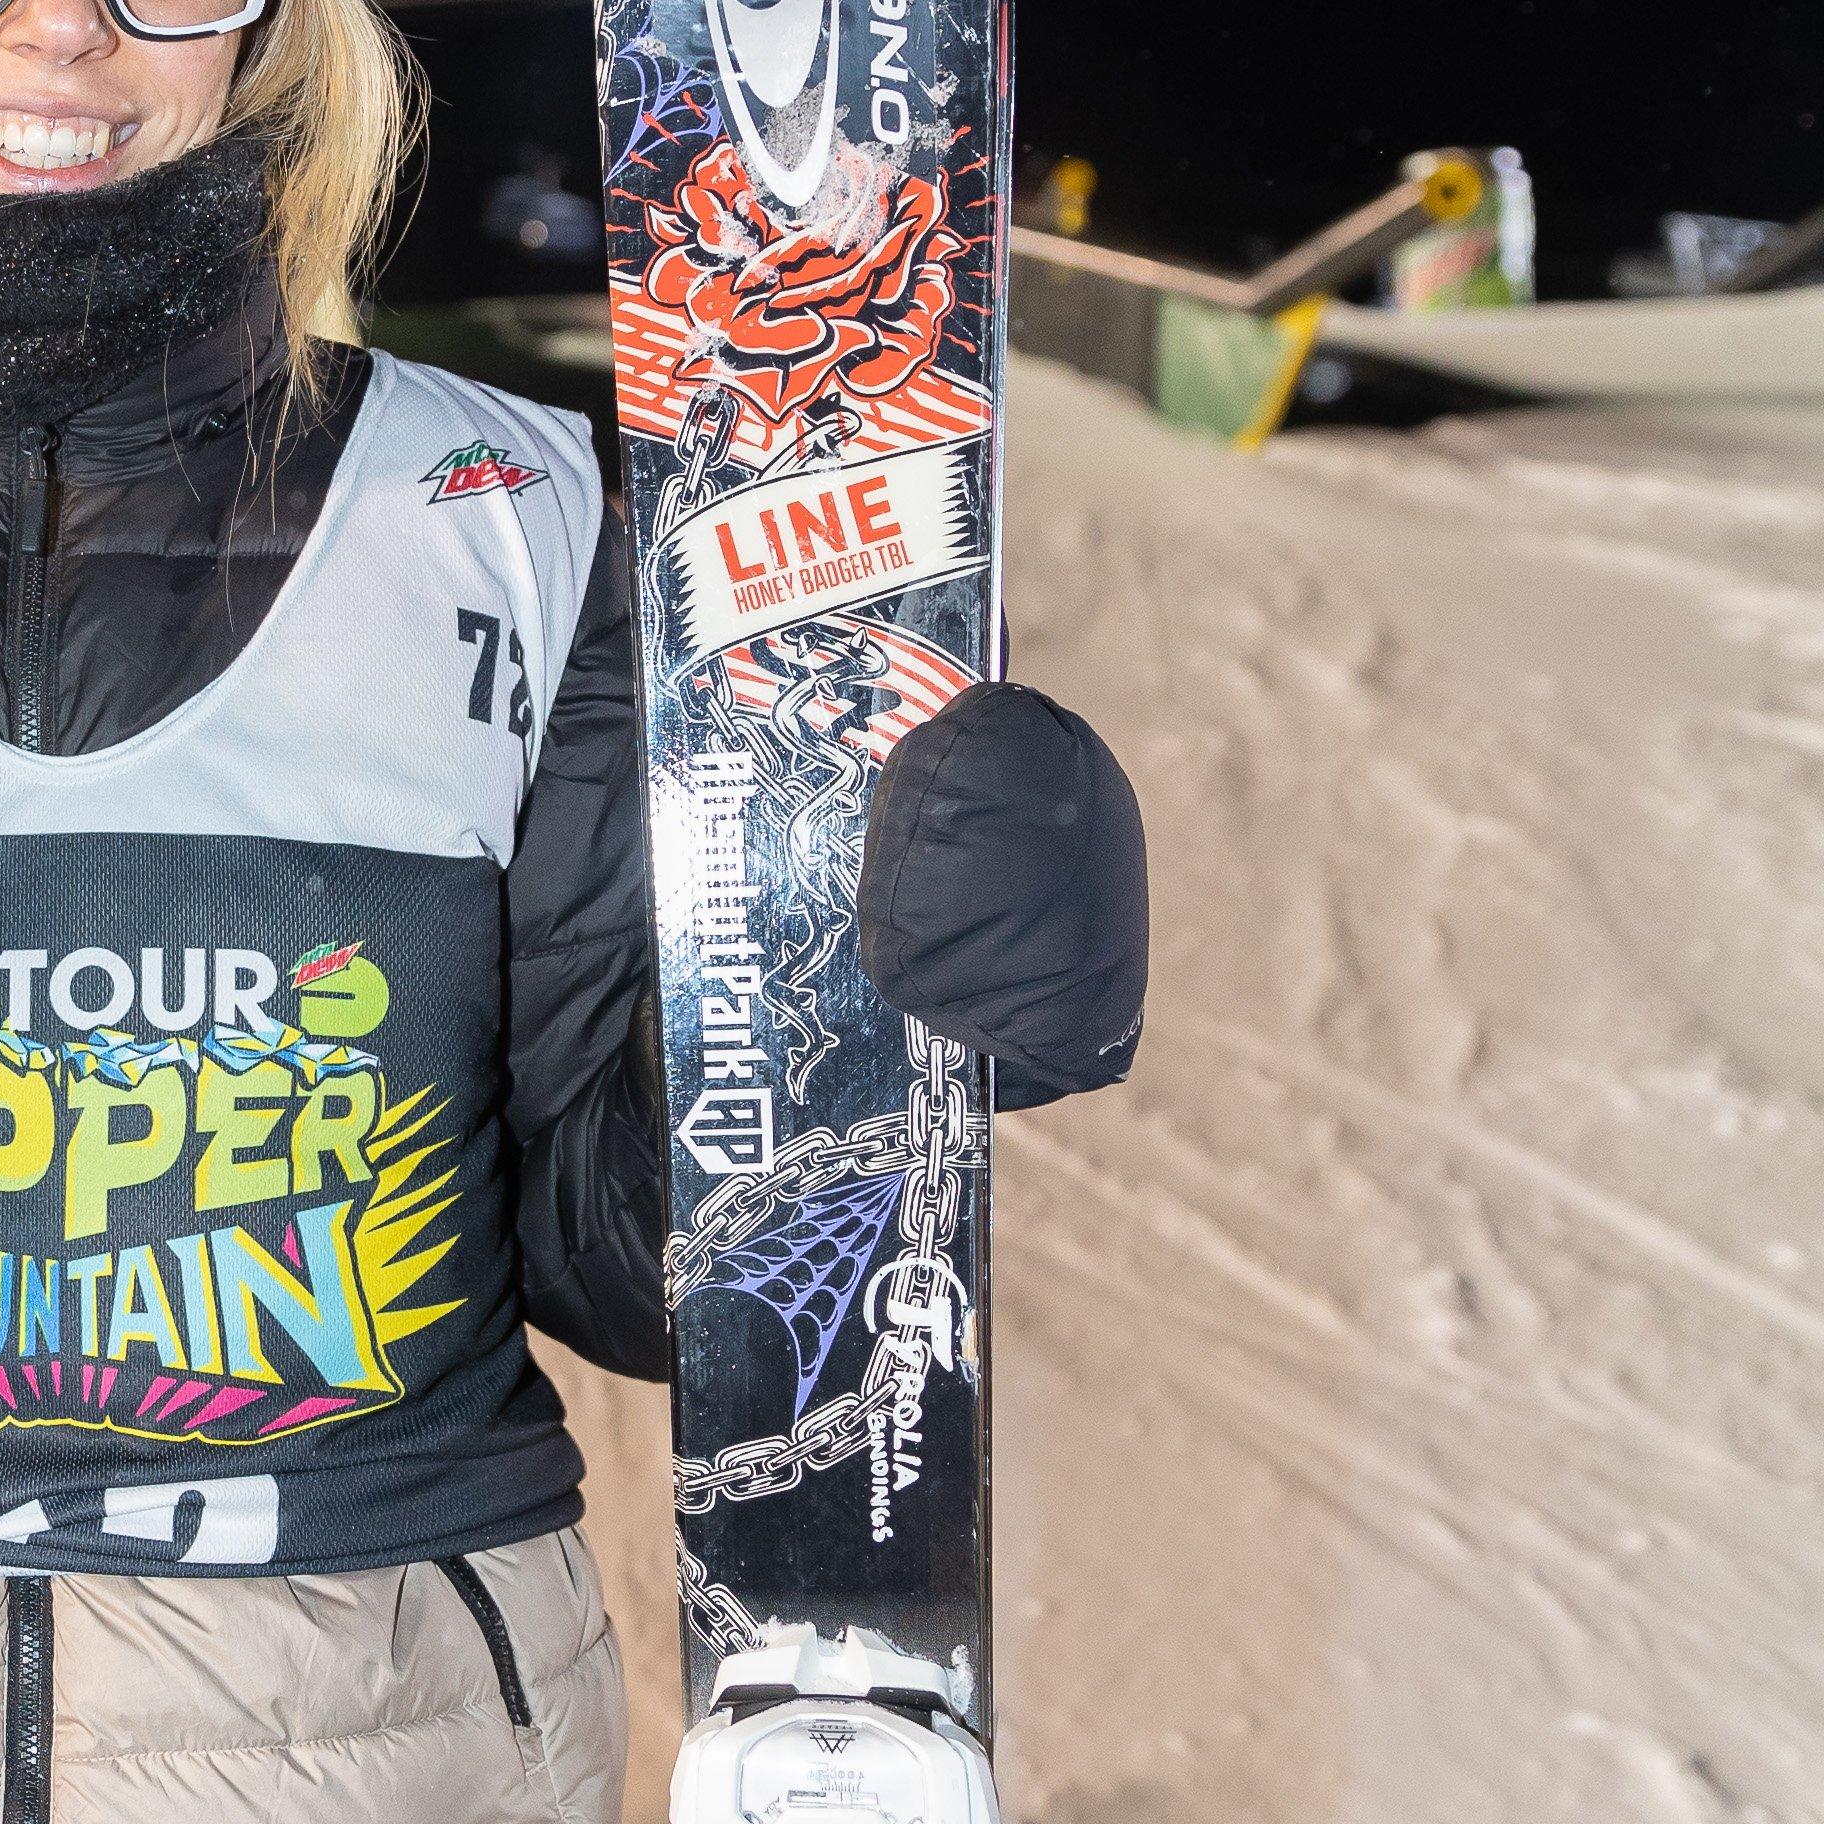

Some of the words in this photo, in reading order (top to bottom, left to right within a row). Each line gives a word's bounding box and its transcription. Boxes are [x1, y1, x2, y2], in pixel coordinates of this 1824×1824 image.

[715, 474, 902, 584] LINE
[733, 573, 795, 615] HONEY
[801, 550, 877, 596] BADGER
[876, 539, 914, 574] TBL
